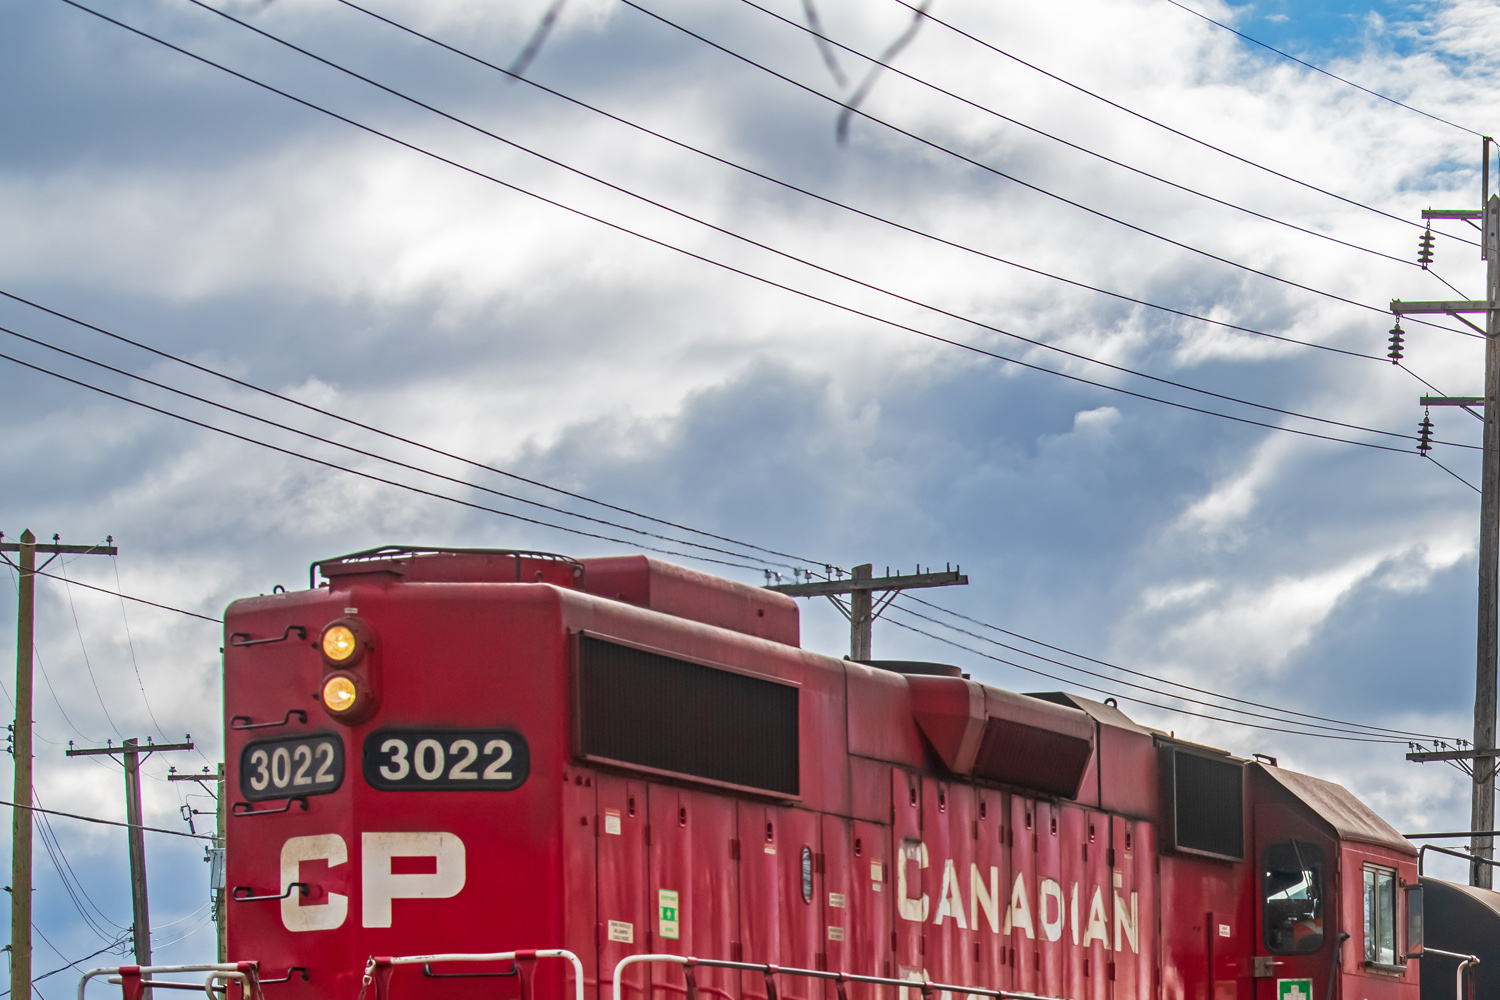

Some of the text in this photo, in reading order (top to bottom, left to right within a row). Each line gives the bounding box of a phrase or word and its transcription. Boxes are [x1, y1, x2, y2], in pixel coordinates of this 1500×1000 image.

[250, 742, 335, 791] 3022
[379, 738, 513, 781] 3022
[280, 831, 466, 932] CP
[897, 841, 1139, 955] CANADIAN
